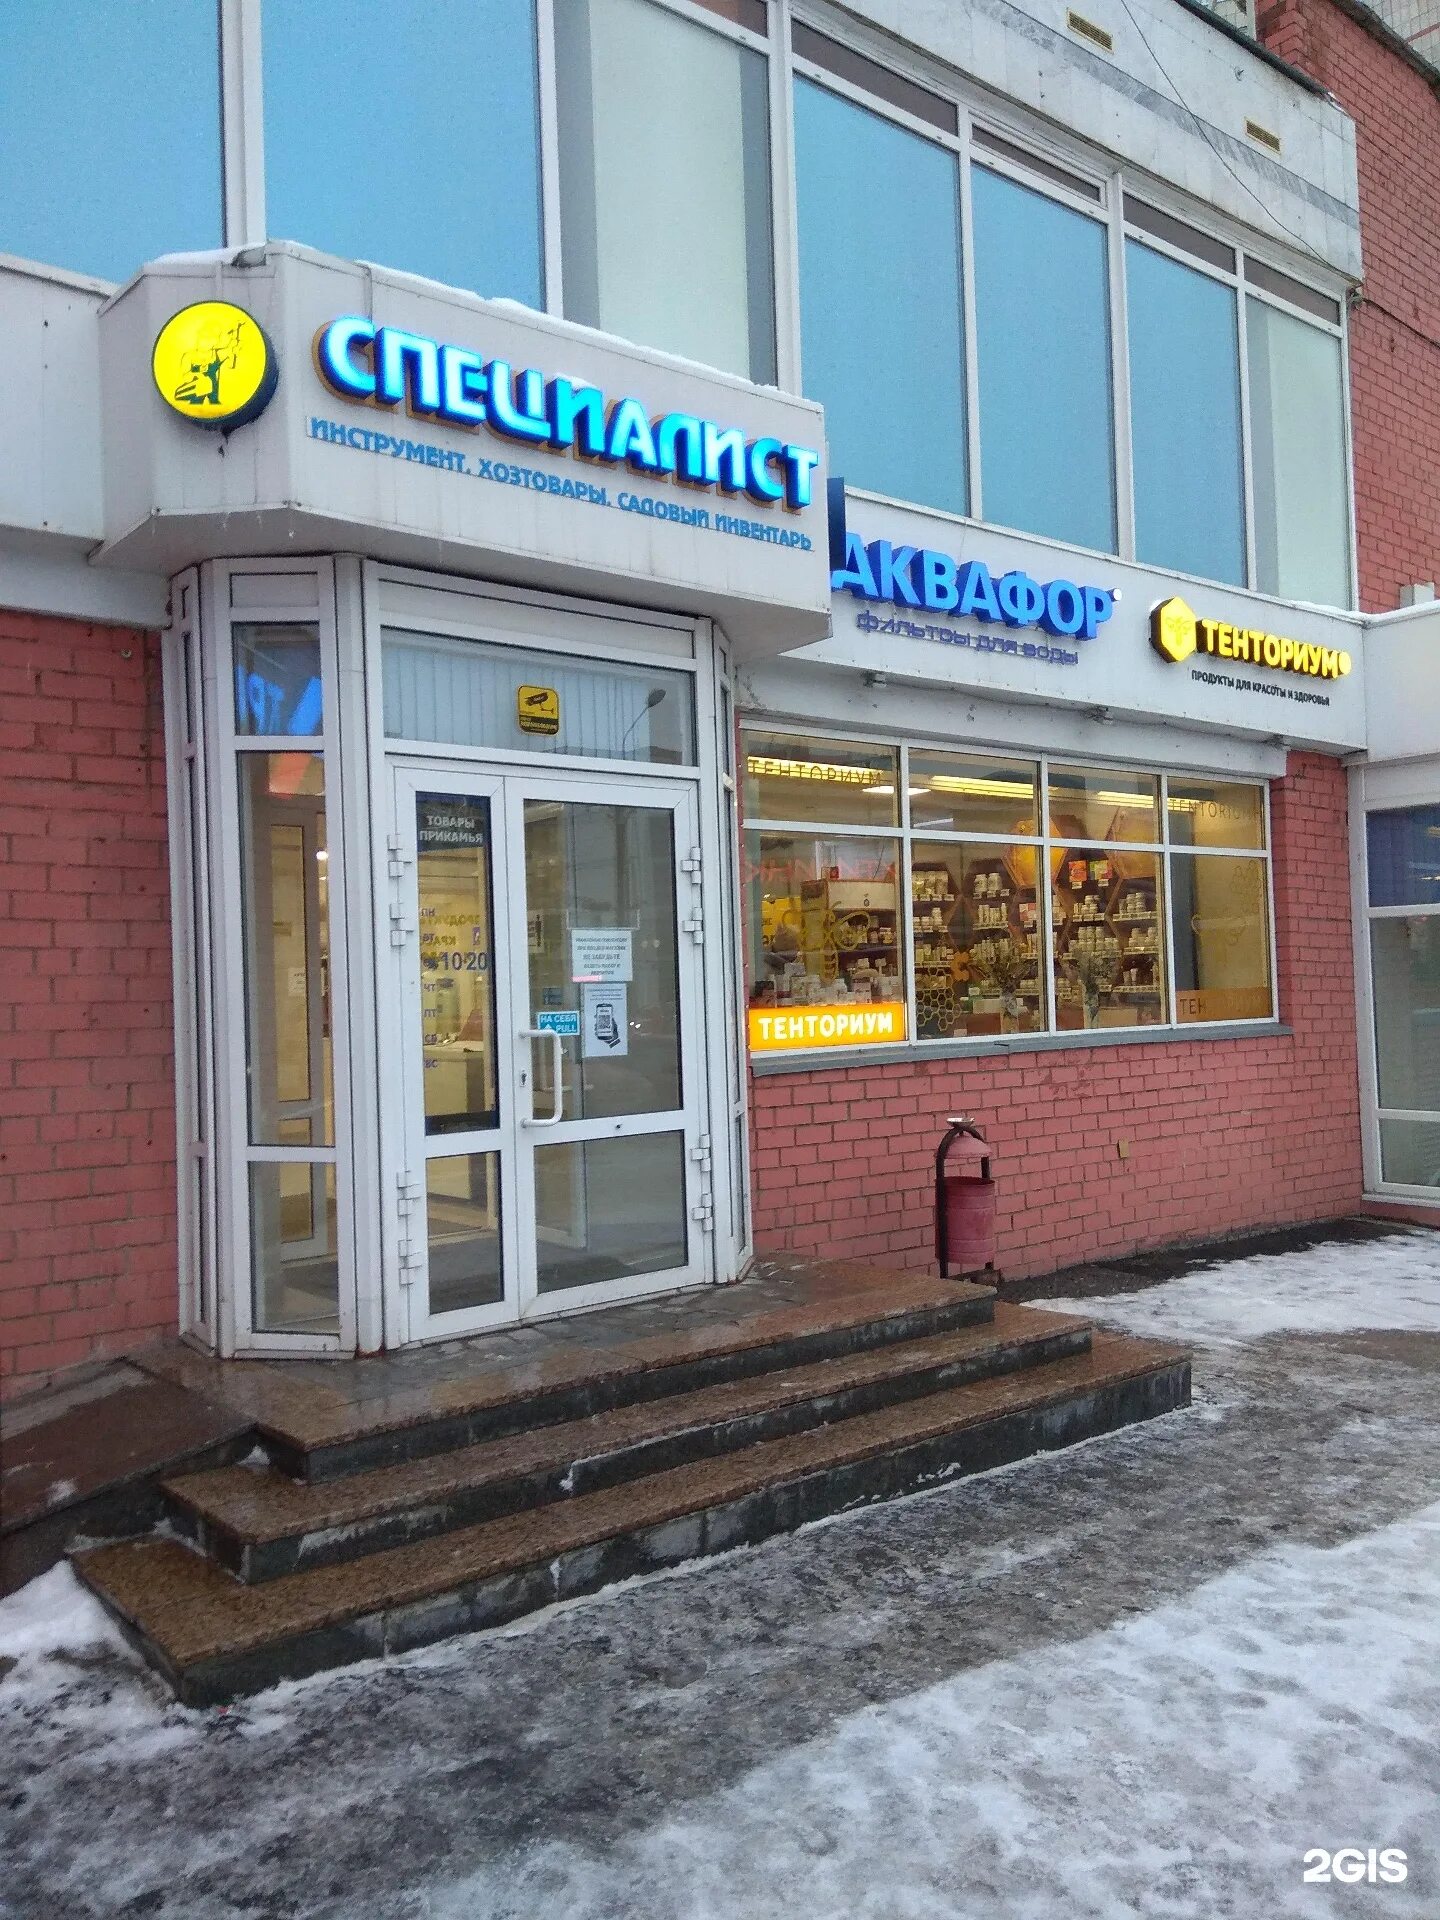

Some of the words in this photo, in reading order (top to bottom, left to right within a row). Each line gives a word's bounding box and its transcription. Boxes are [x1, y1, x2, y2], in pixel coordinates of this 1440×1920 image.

[313, 316, 820, 512] СПЕЦИАЛИСТ
[617, 491, 709, 529] САДОВЫЙ
[714, 513, 812, 552] ИНВЕНТАРЬ
[832, 531, 1114, 641] АКВАФОР
[1199, 618, 1340, 679] ТЕНТОРИУМ
[1191, 668, 1235, 688] ПРОДУКТЫ
[1236, 678, 1251, 691] ДЛЯ
[1252, 682, 1286, 699] КРАСОТЫ
[1287, 691, 1294, 700] И
[1294, 690, 1330, 707] ЗДОРОВЬЯ
[419, 830, 484, 844] ПРИКАМЬЯ
[426, 815, 475, 829] ТОВАРЫ
[540, 1014, 553, 1023] НА
[553, 1014, 577, 1023] СЕБЯ
[555, 1024, 576, 1033] PULL
[758, 1011, 893, 1040] ТЕНТОРИУМ
